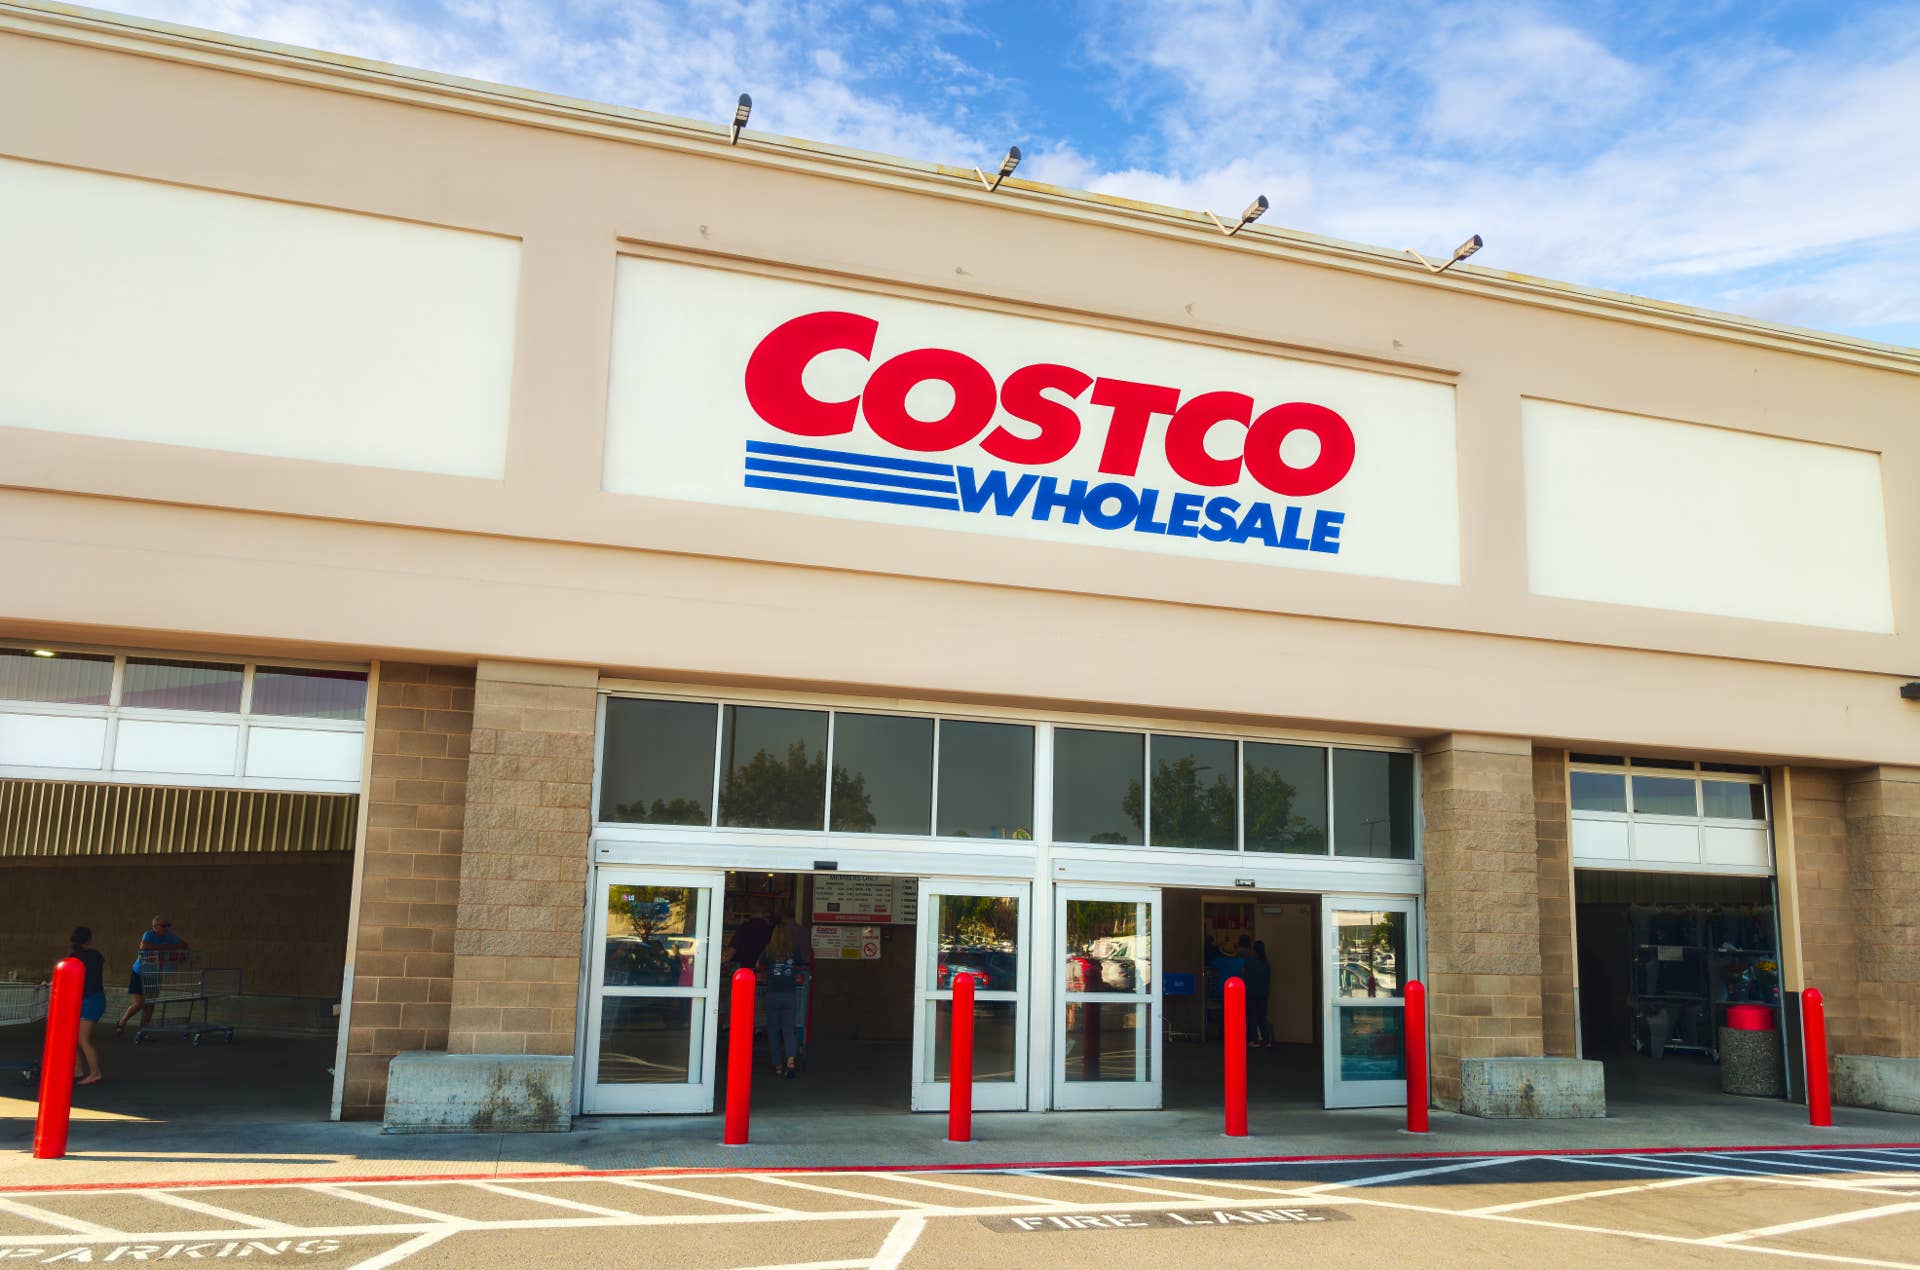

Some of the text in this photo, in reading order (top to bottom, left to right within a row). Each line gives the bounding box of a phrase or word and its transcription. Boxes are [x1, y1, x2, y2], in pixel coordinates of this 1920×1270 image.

[745, 311, 1355, 497] COSTCO
[955, 465, 1345, 555] WHOLESALE
[1010, 1208, 1325, 1230] FIRE LANE
[0, 1240, 340, 1263] PARKING
